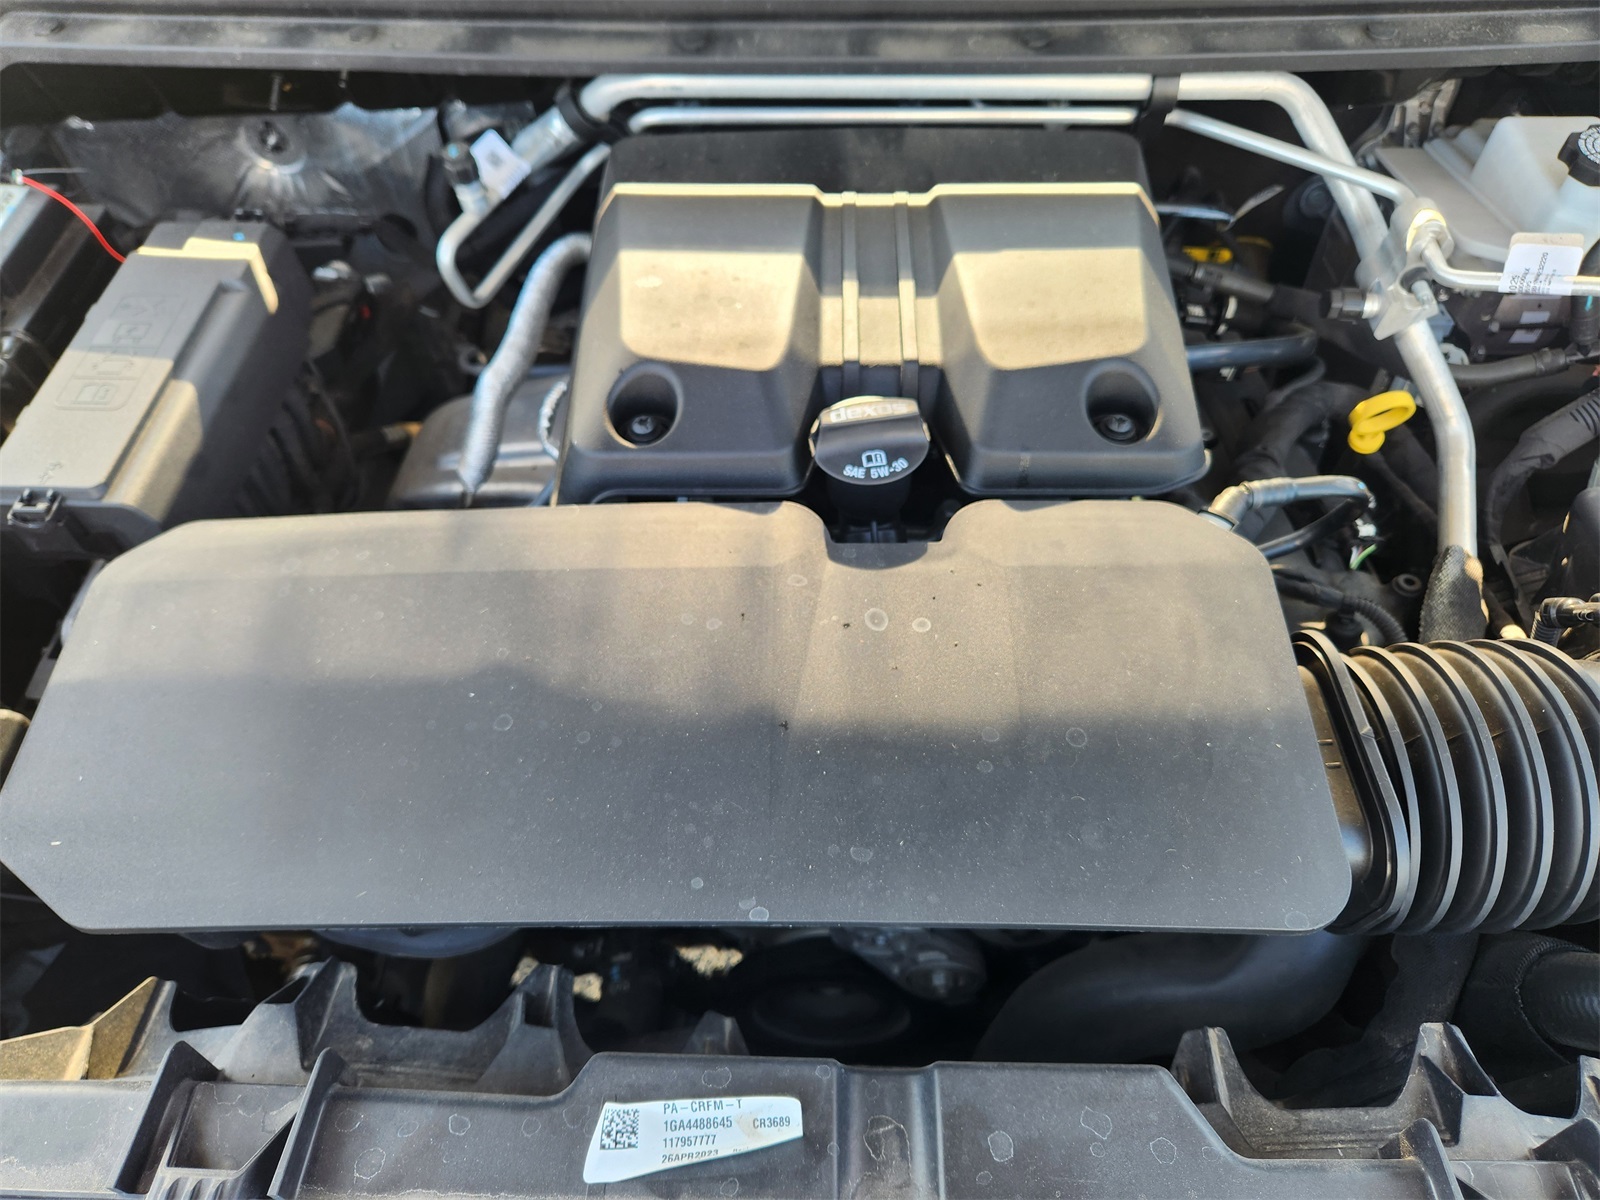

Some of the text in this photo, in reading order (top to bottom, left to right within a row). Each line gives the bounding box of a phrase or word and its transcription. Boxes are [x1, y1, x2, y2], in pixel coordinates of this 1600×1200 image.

[842, 457, 909, 479] SAE 5W-30
[663, 1116, 791, 1132] 1GA4488645 CR3689
[663, 1134, 717, 1149] 117957777
[661, 1149, 719, 1164] 26APR2023
